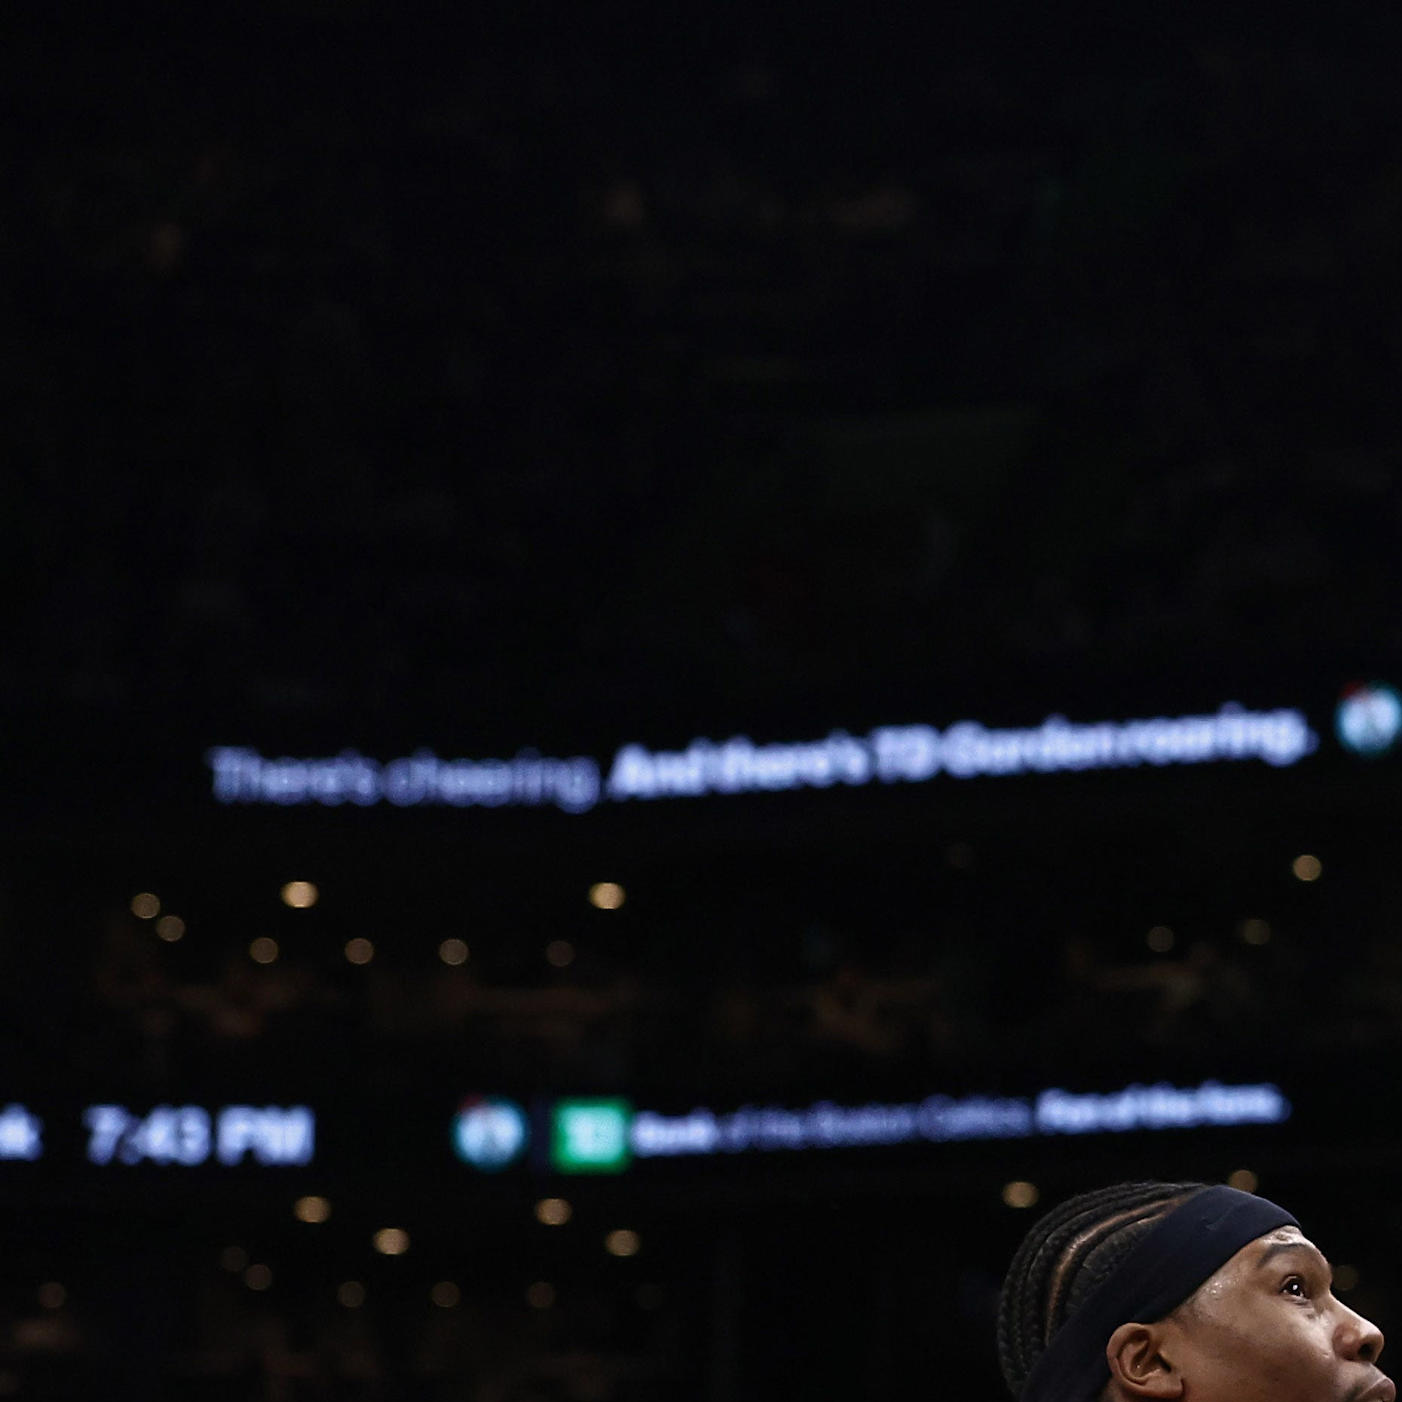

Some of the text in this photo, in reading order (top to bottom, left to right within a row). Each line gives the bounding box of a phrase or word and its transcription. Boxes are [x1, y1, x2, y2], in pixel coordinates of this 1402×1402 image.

[605, 742, 704, 799] And
[939, 717, 1109, 777] Garden
[85, 1105, 210, 1165] 7:43
[214, 1105, 315, 1165] PM
